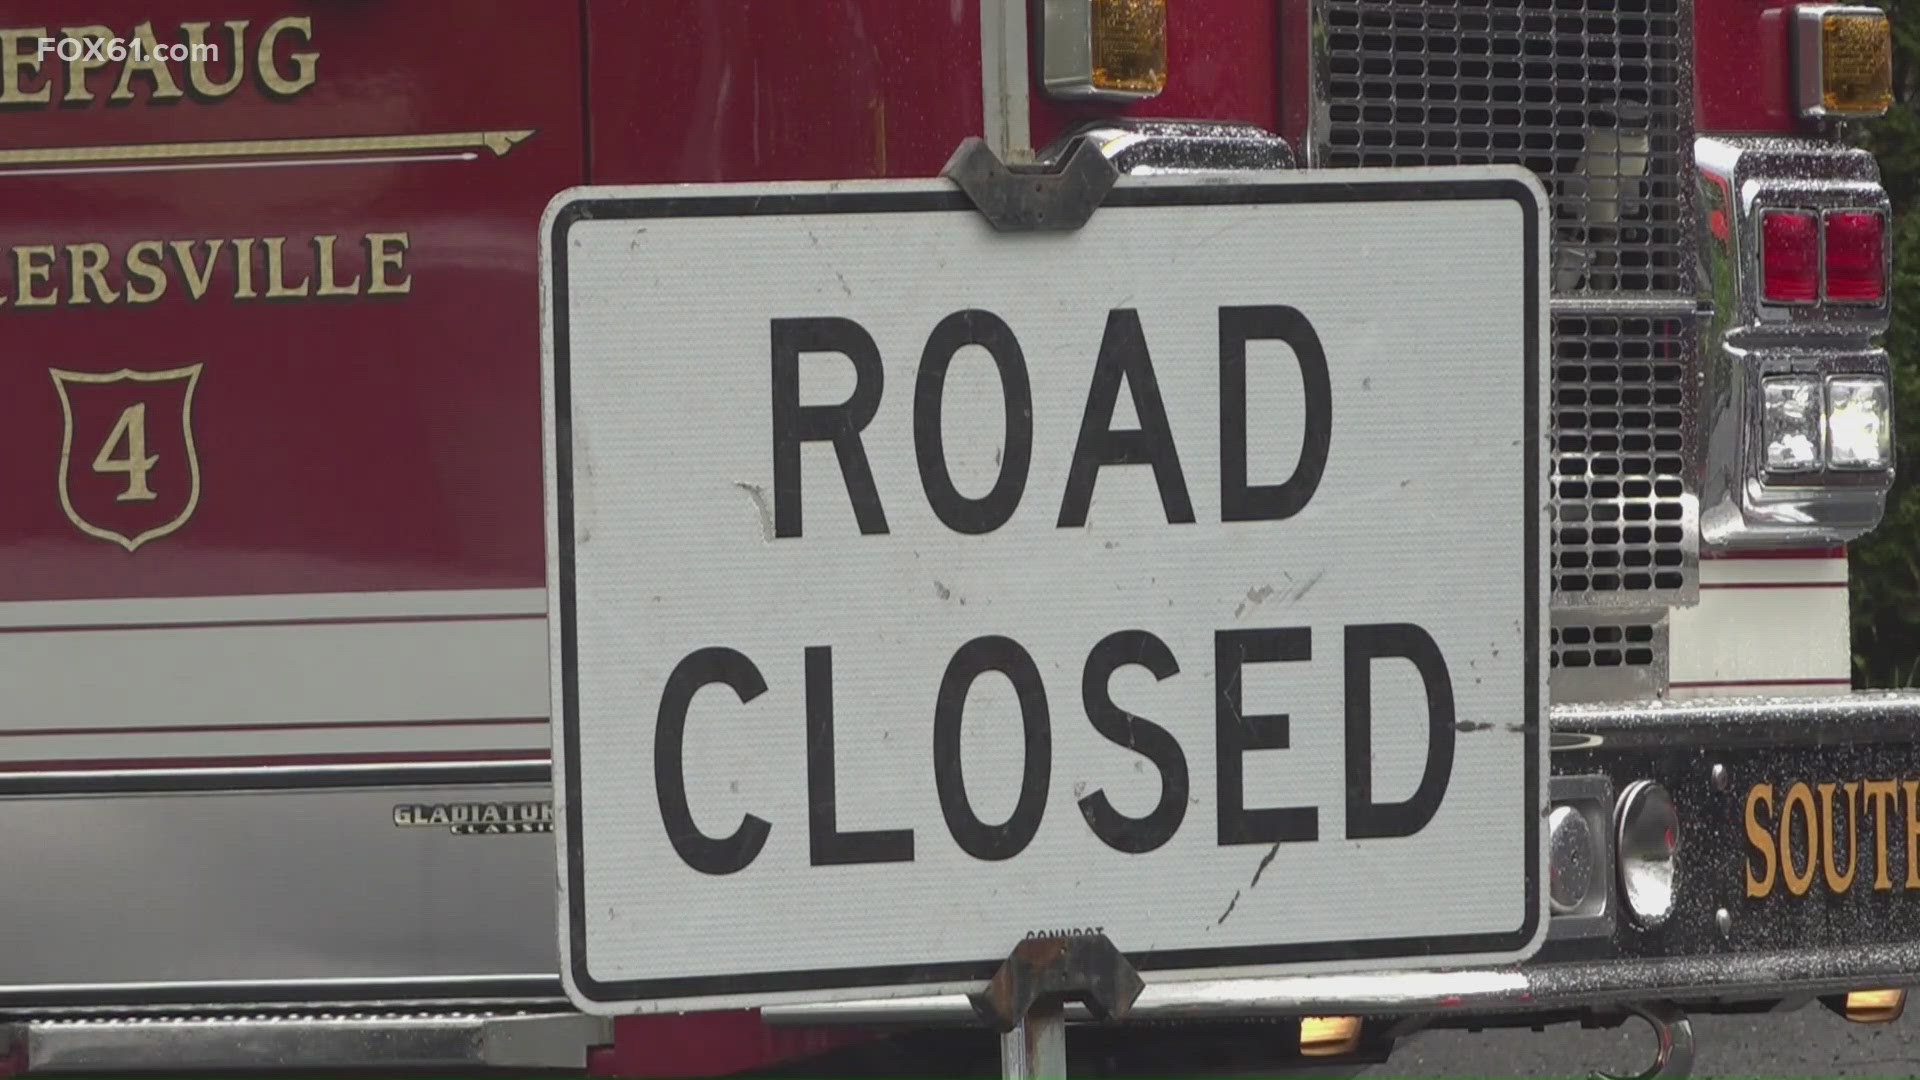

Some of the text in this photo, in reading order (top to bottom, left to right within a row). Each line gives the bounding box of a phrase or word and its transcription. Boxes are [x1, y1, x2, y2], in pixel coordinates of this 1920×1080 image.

[0, 232, 412, 306] ERSVILLE
[92, 402, 159, 500] 4
[771, 305, 1333, 539] ROAD
[655, 624, 1455, 875] CLOSED
